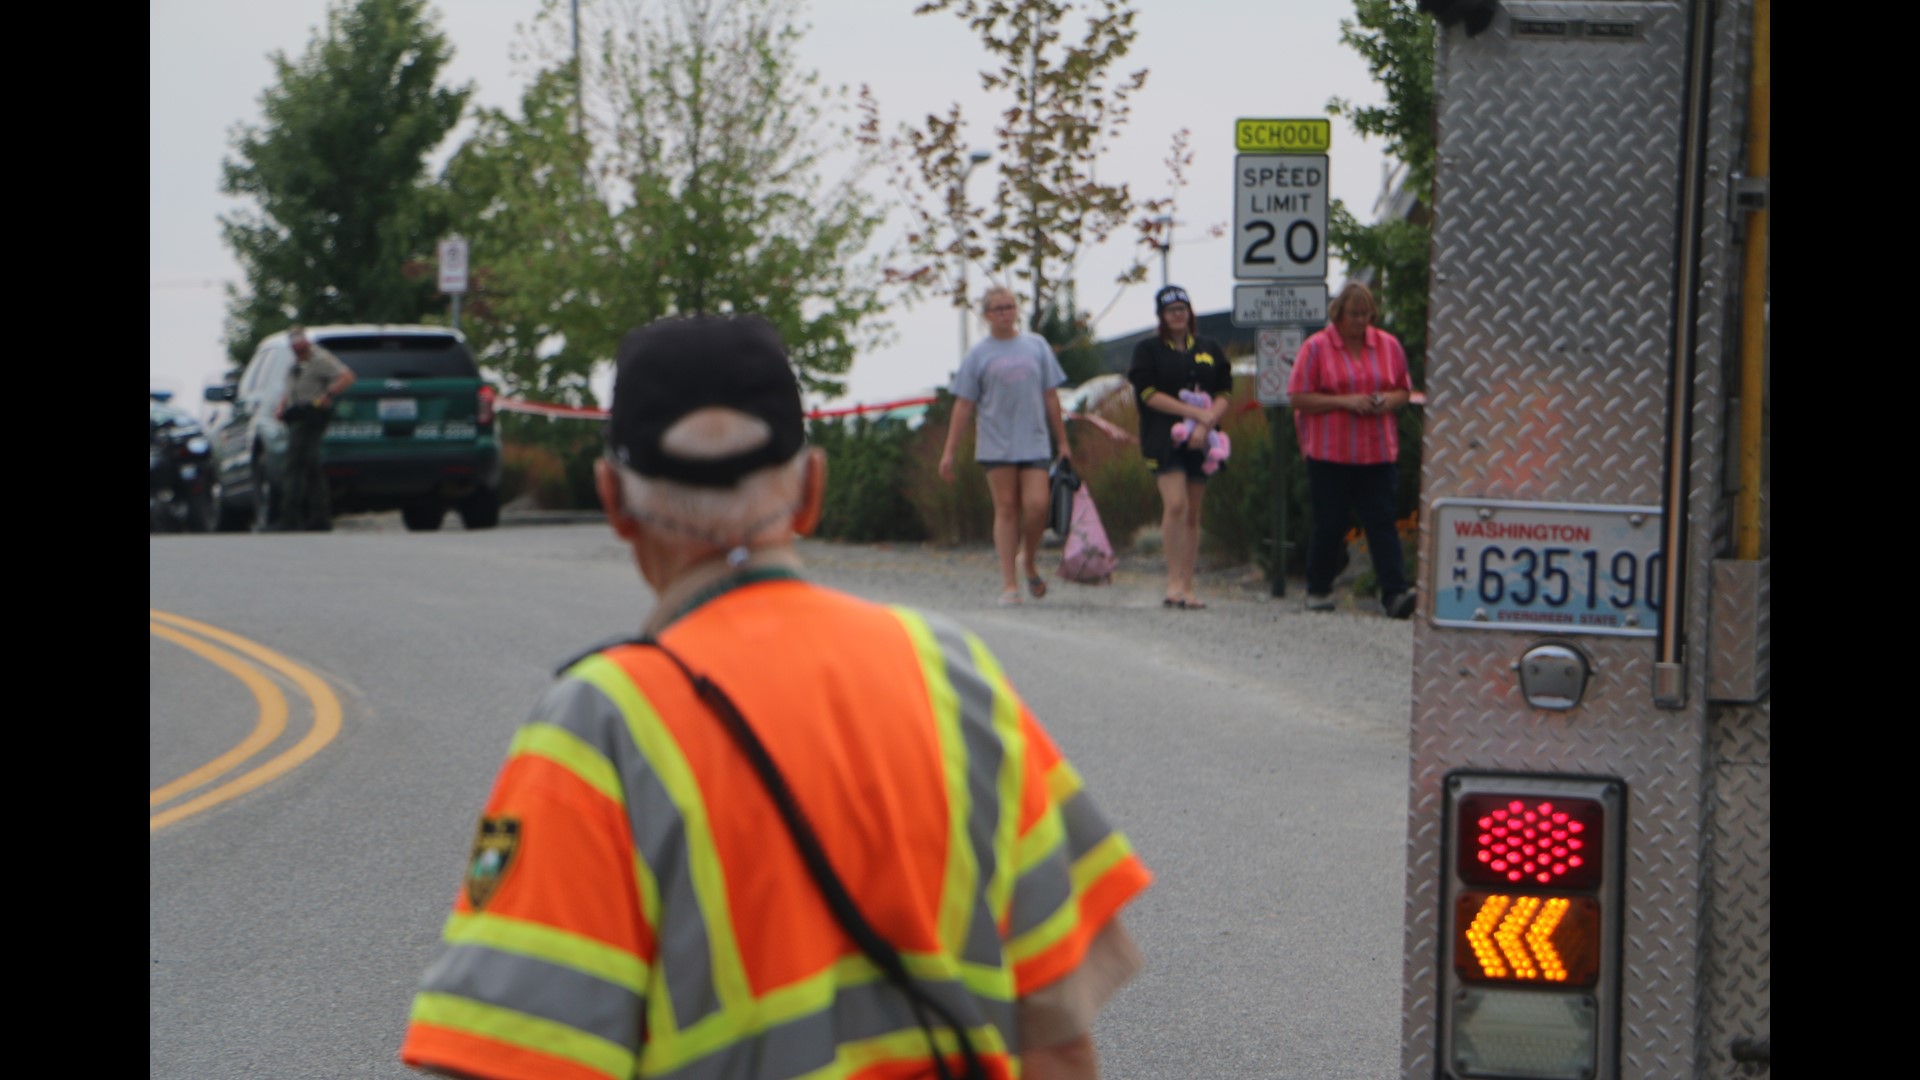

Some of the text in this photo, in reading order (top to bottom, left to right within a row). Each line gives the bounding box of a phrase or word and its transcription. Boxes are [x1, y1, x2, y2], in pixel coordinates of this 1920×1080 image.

[1241, 124, 1324, 146] SCHOOL
[1243, 168, 1321, 188] SPEED
[1251, 193, 1312, 214] LIMIT
[1243, 219, 1320, 265] 20
[1265, 288, 1295, 297] WHEN
[1254, 298, 1307, 308] CHILDREN
[1242, 308, 1320, 320] ARE PRESENT
[1453, 521, 1591, 543] WASHINGTON
[1497, 610, 1618, 625] EVERGREEN STATE
